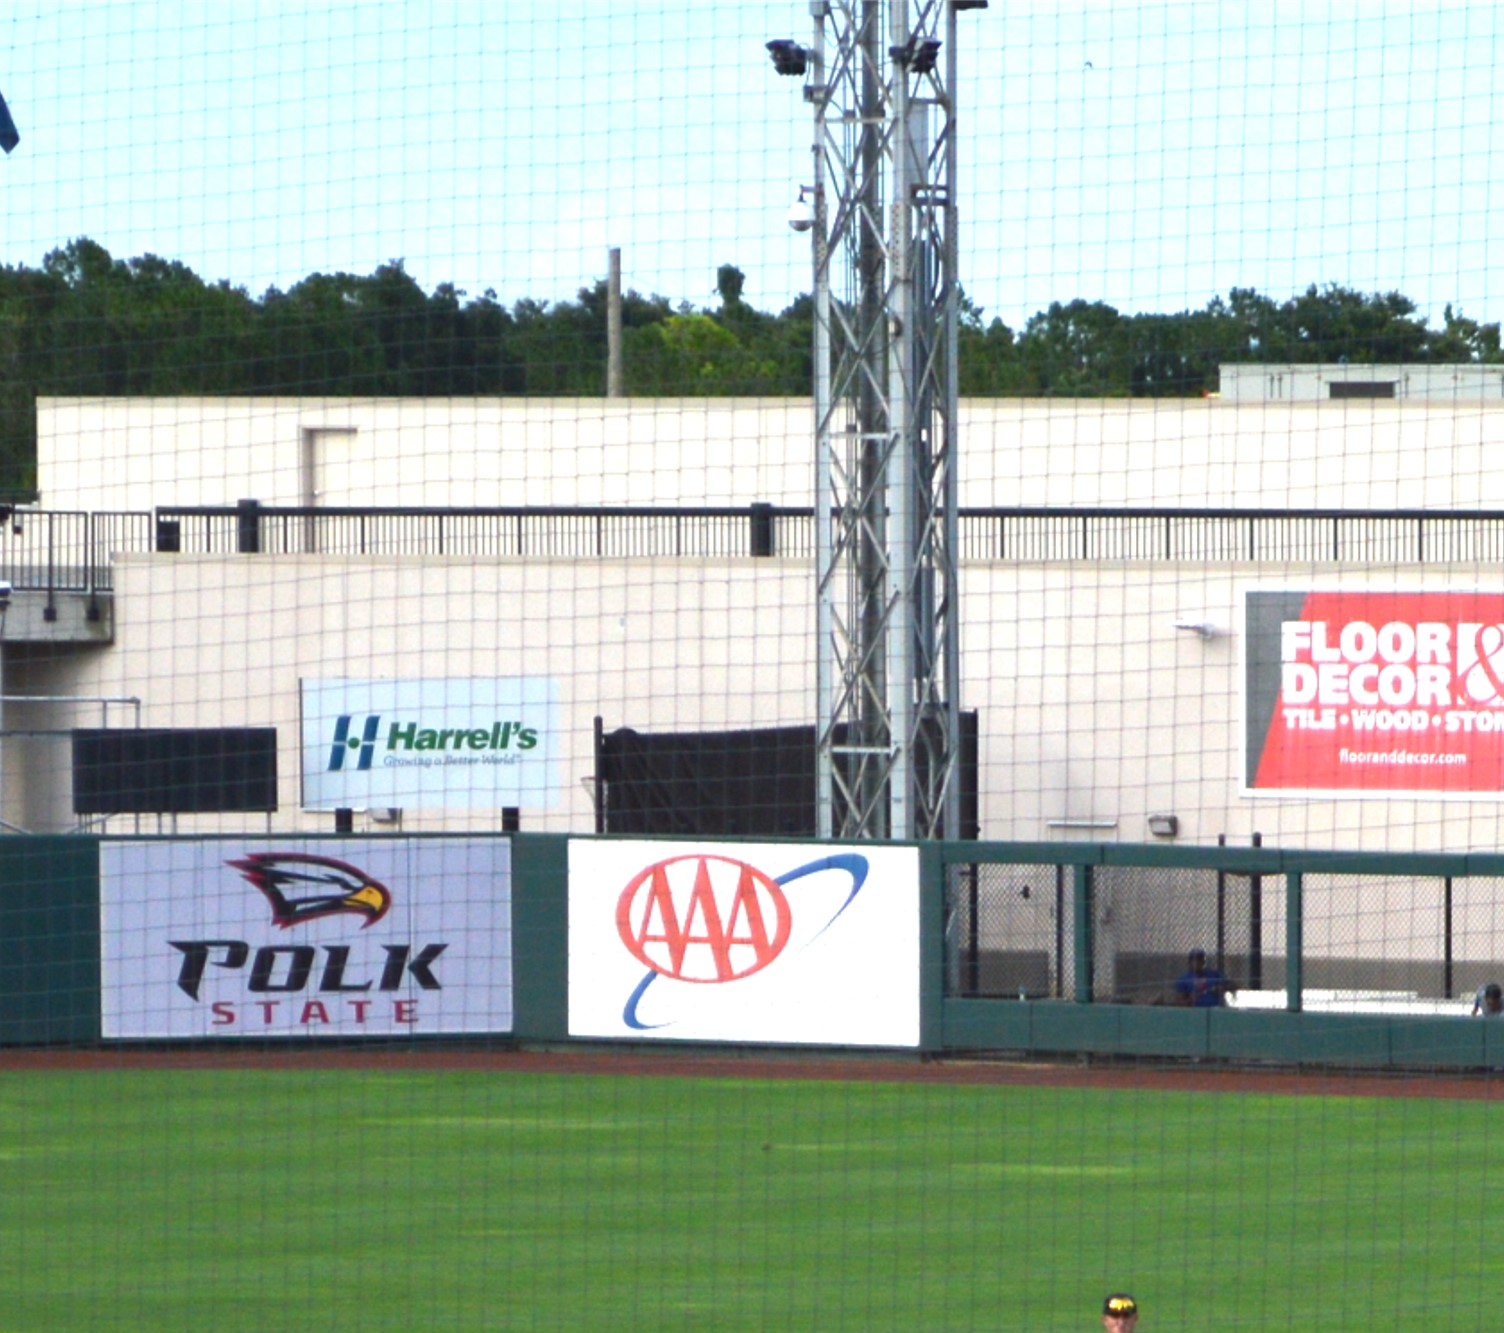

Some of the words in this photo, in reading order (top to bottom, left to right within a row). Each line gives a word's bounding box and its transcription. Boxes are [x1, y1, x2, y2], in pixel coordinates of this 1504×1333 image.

[1281, 621, 1452, 663] FLOOR
[1281, 663, 1452, 705] DECOR
[387, 721, 538, 750] Harrell's
[1283, 709, 1336, 730] TILE
[1351, 709, 1429, 730] WOOD
[1339, 748, 1466, 764] flooranddecor.com
[630, 856, 780, 982] AAA
[166, 940, 449, 1002] POLK
[212, 999, 419, 1025] STATE
